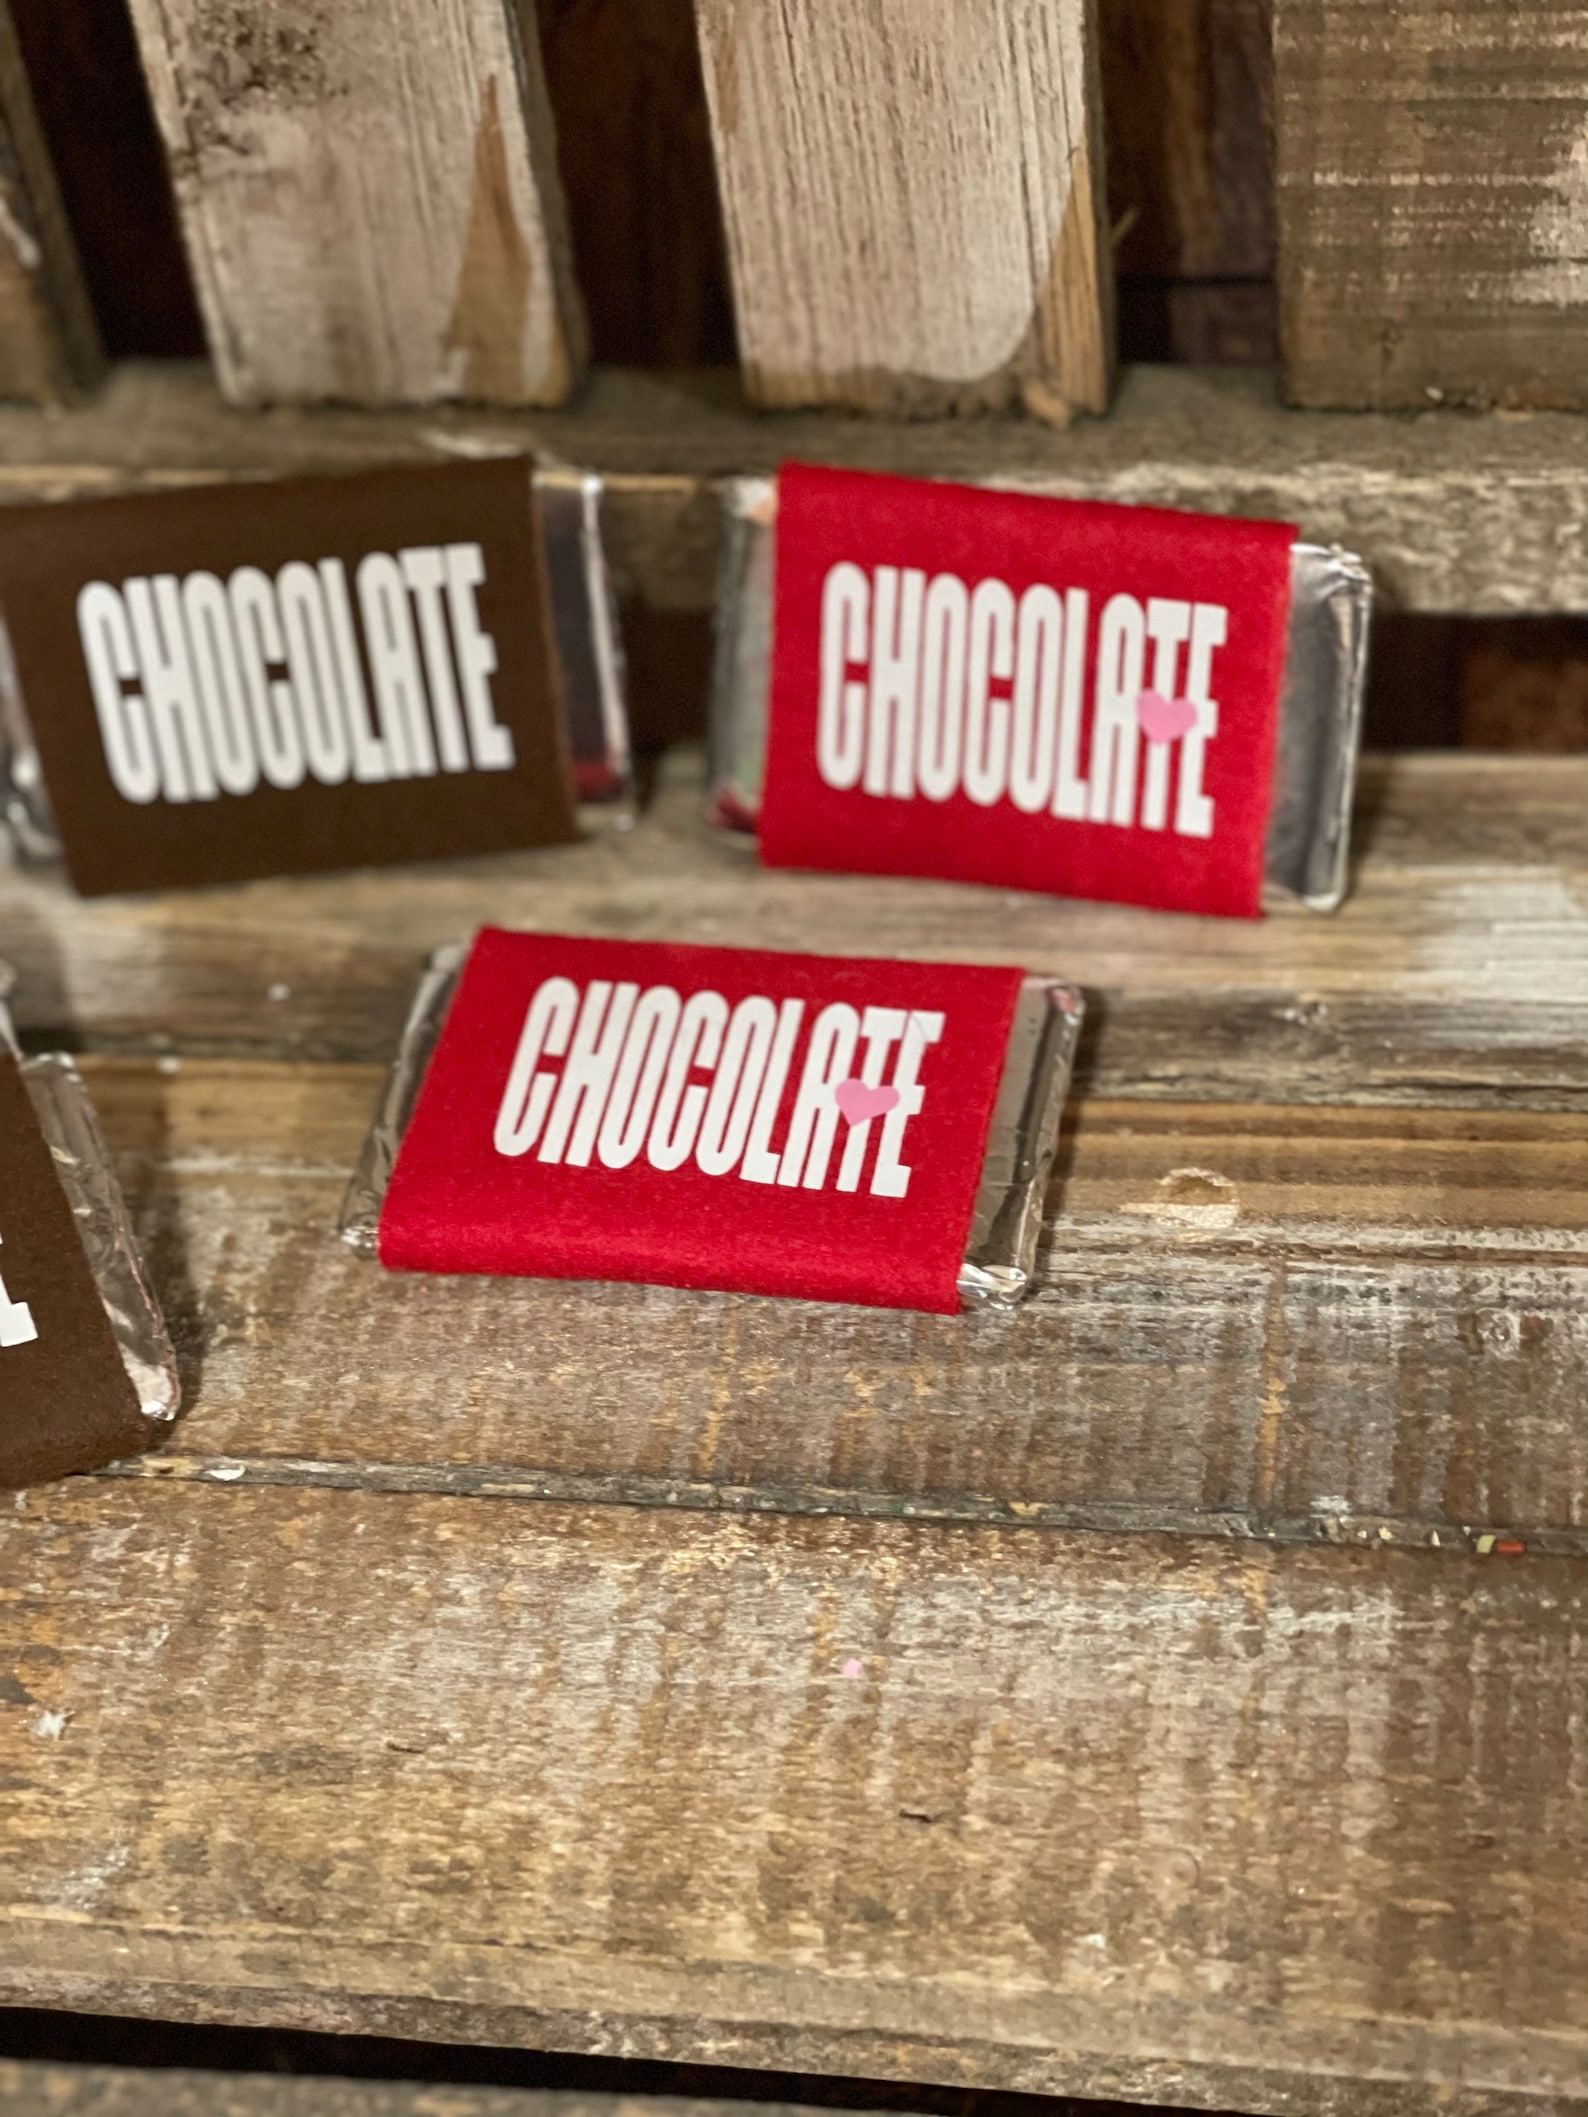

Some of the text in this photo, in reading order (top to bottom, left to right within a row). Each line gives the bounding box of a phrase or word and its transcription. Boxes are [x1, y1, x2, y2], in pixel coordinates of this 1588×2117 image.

[77, 542, 516, 804] CHOCOLATE
[817, 561, 1228, 838] CHOCOLATE
[493, 976, 945, 1198] CHOCOLATE
